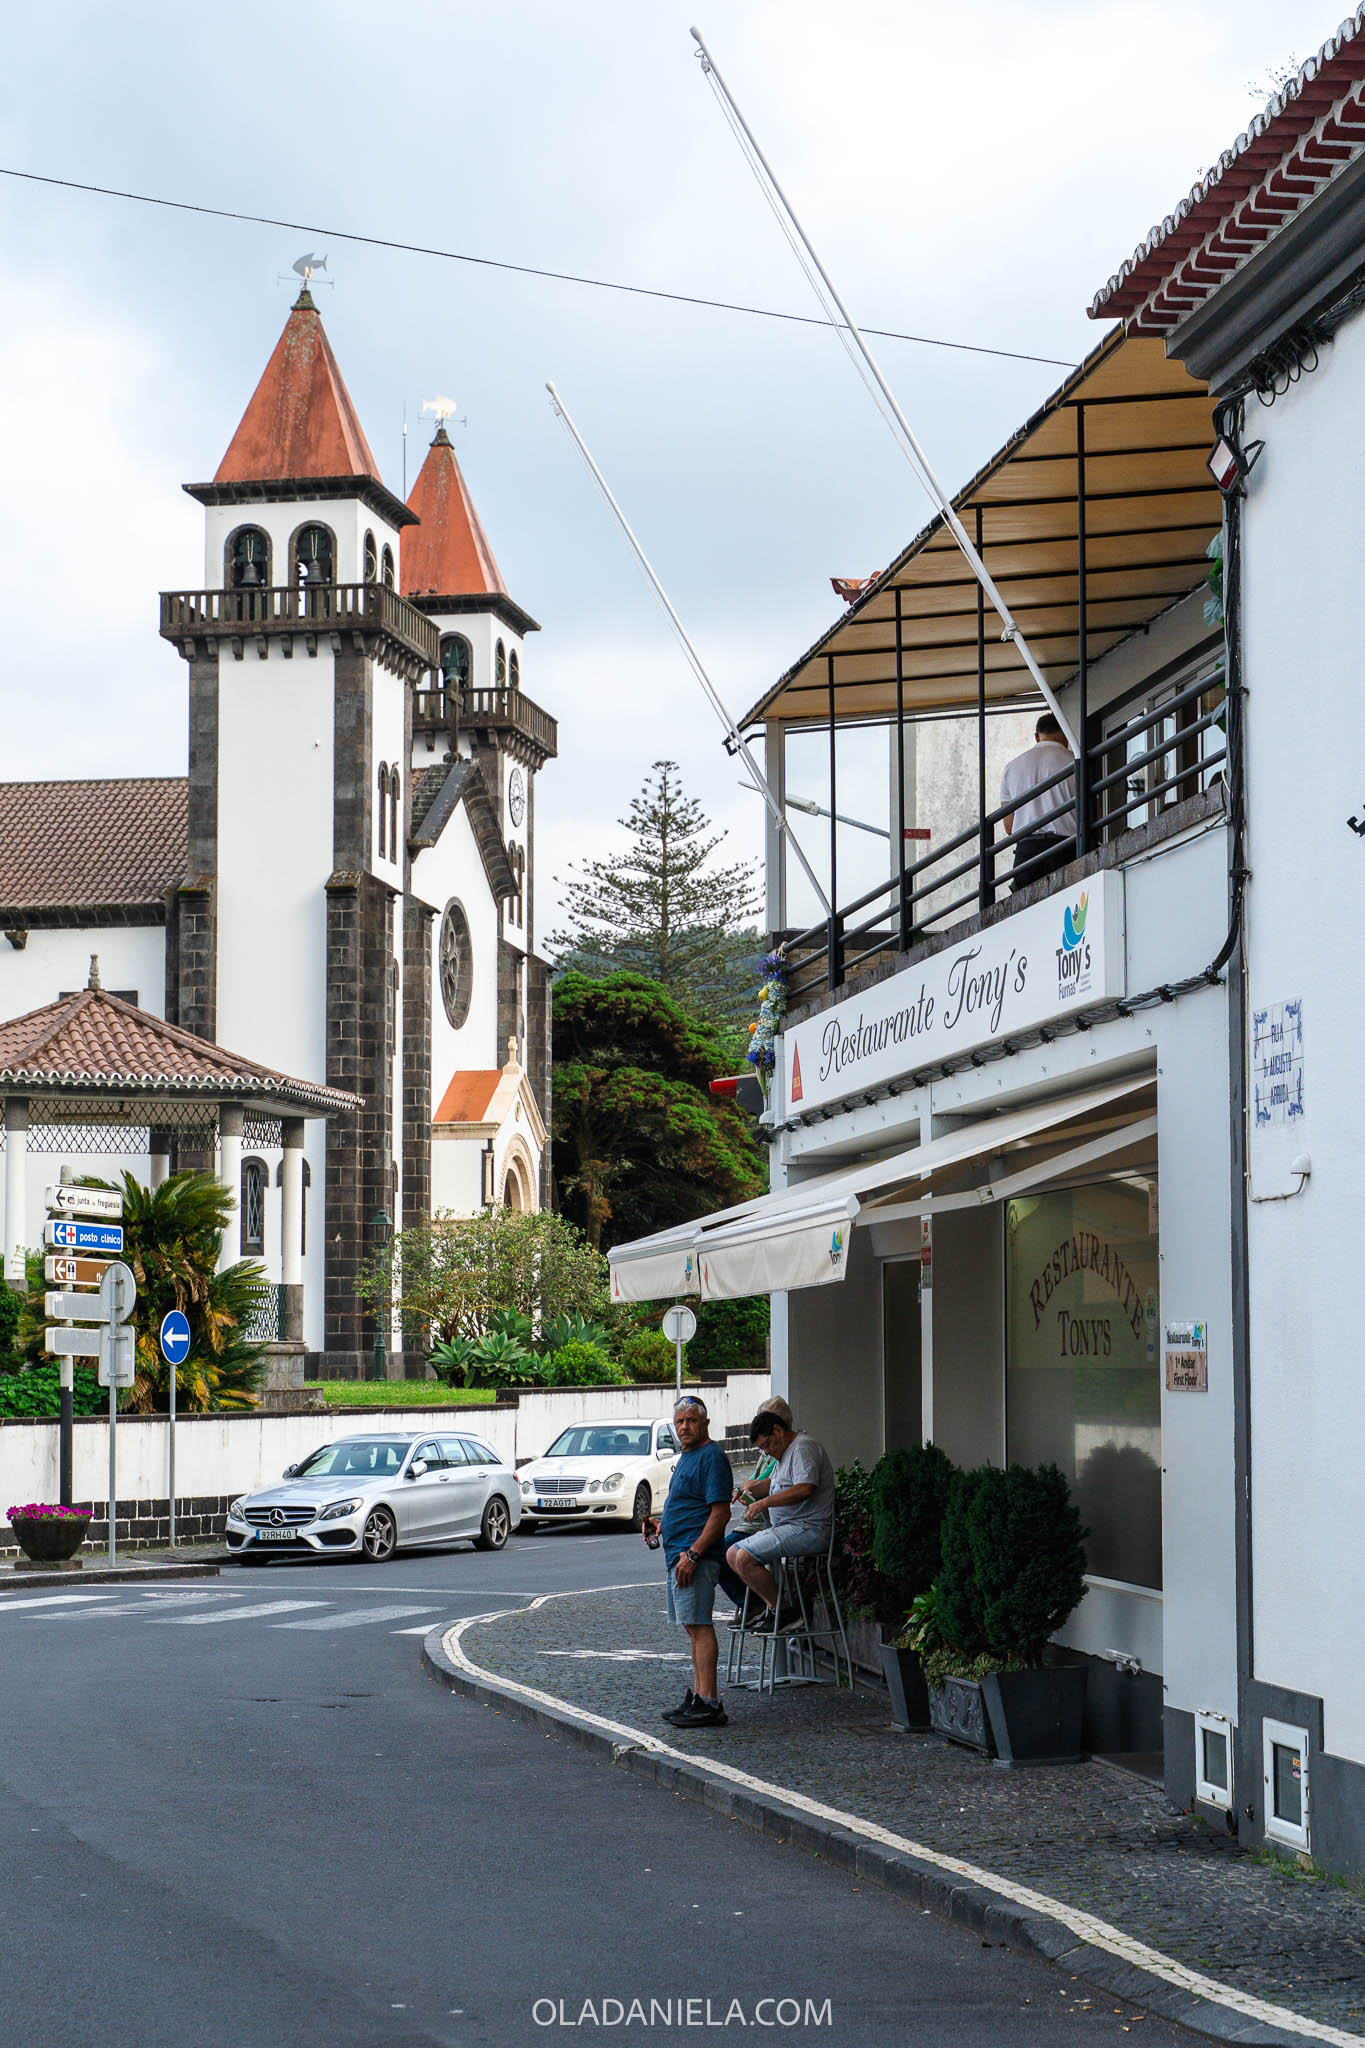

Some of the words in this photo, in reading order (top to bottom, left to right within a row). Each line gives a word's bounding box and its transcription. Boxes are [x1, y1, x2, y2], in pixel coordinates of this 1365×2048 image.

[1059, 982, 1076, 1001] Furnas
[819, 984, 935, 1082] Restaurante
[1271, 1023, 1284, 1044] RUA
[77, 1196, 90, 1206] junta
[97, 1199, 120, 1209] freguesia
[80, 1232, 98, 1242] posto
[101, 1233, 121, 1245] clínico
[1029, 1232, 1144, 1340] RESTAURANTE
[1181, 1356, 1196, 1369] Andar
[1174, 1373, 1184, 1386] First
[1185, 1373, 1197, 1386] Floor
[261, 1530, 292, 1539] 92RH40
